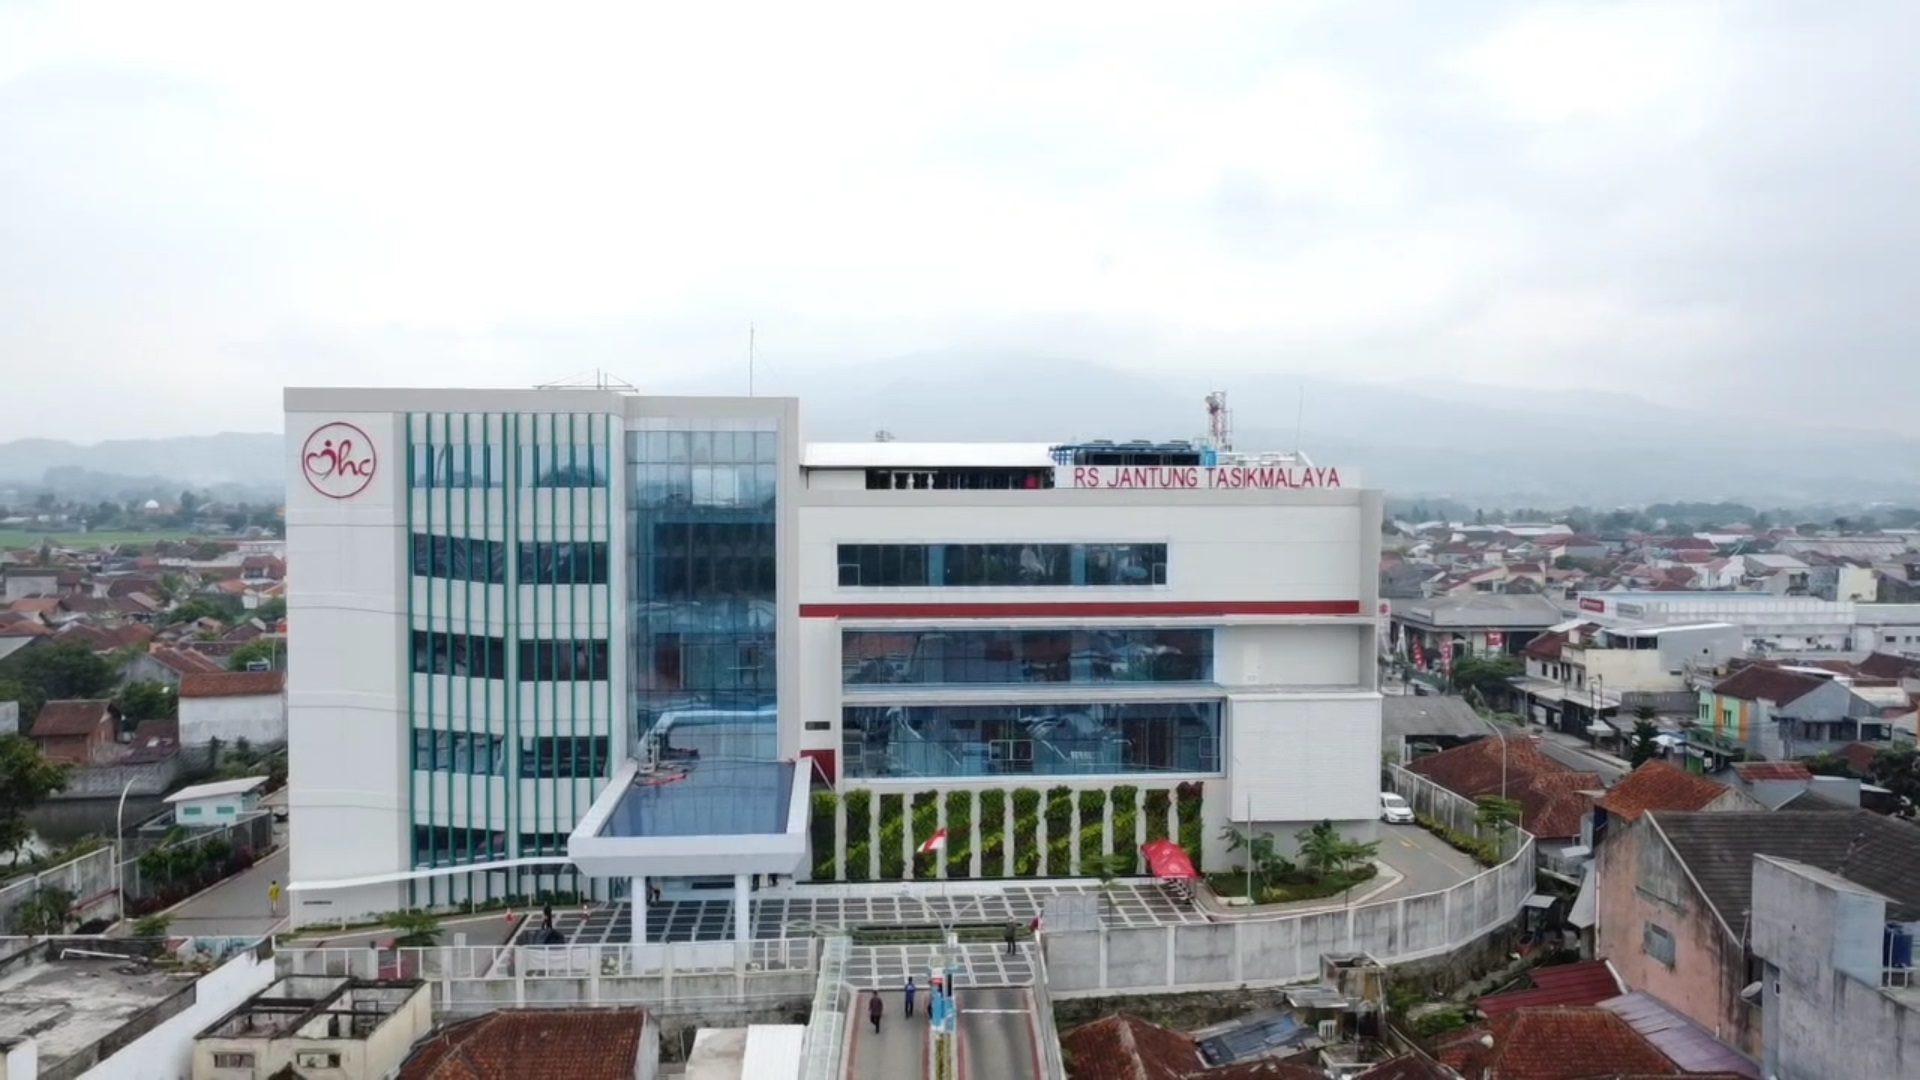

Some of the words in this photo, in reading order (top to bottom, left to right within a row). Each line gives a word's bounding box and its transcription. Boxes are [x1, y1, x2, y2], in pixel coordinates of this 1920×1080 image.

[1074, 467, 1098, 488] RS
[1107, 467, 1197, 488] JANTUNG
[1206, 467, 1340, 488] TASIKMALAYA
